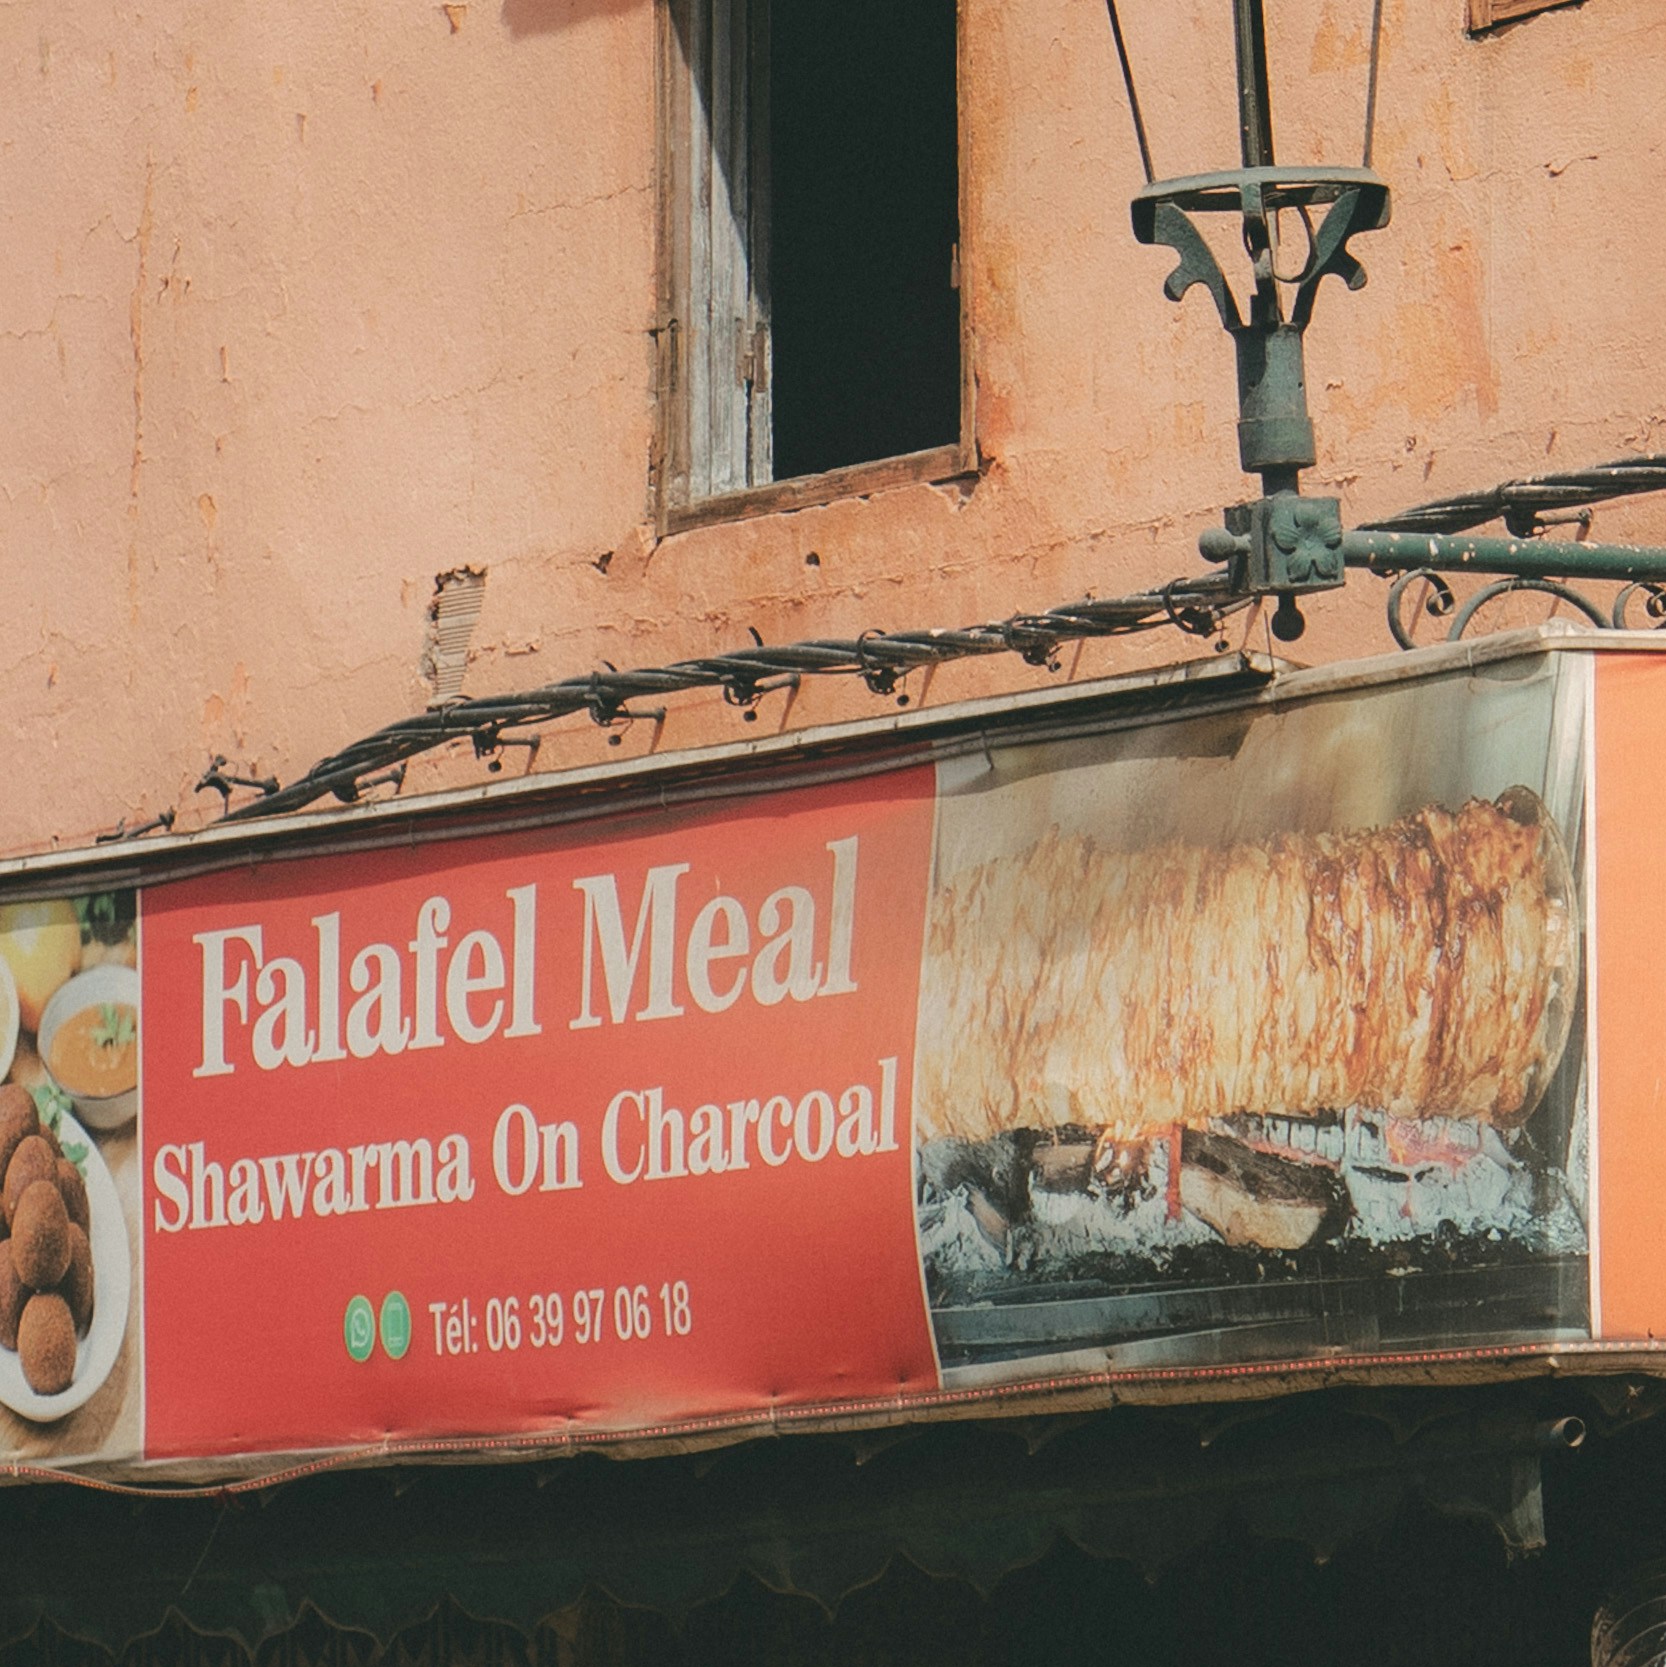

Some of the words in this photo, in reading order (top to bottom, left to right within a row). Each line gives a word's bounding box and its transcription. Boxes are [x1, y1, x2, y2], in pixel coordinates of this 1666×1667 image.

[192, 883, 542, 1079] Falafel
[568, 835, 859, 1030] Meal
[152, 1132, 476, 1232] Shawarma
[493, 1104, 583, 1196] On
[601, 1056, 899, 1184] Charcoal
[429, 1298, 478, 1356] Tél:
[486, 1296, 521, 1351] 06
[529, 1293, 564, 1348] 39
[573, 1289, 605, 1344] 97
[614, 1285, 651, 1341] 06
[660, 1280, 692, 1336] 18
